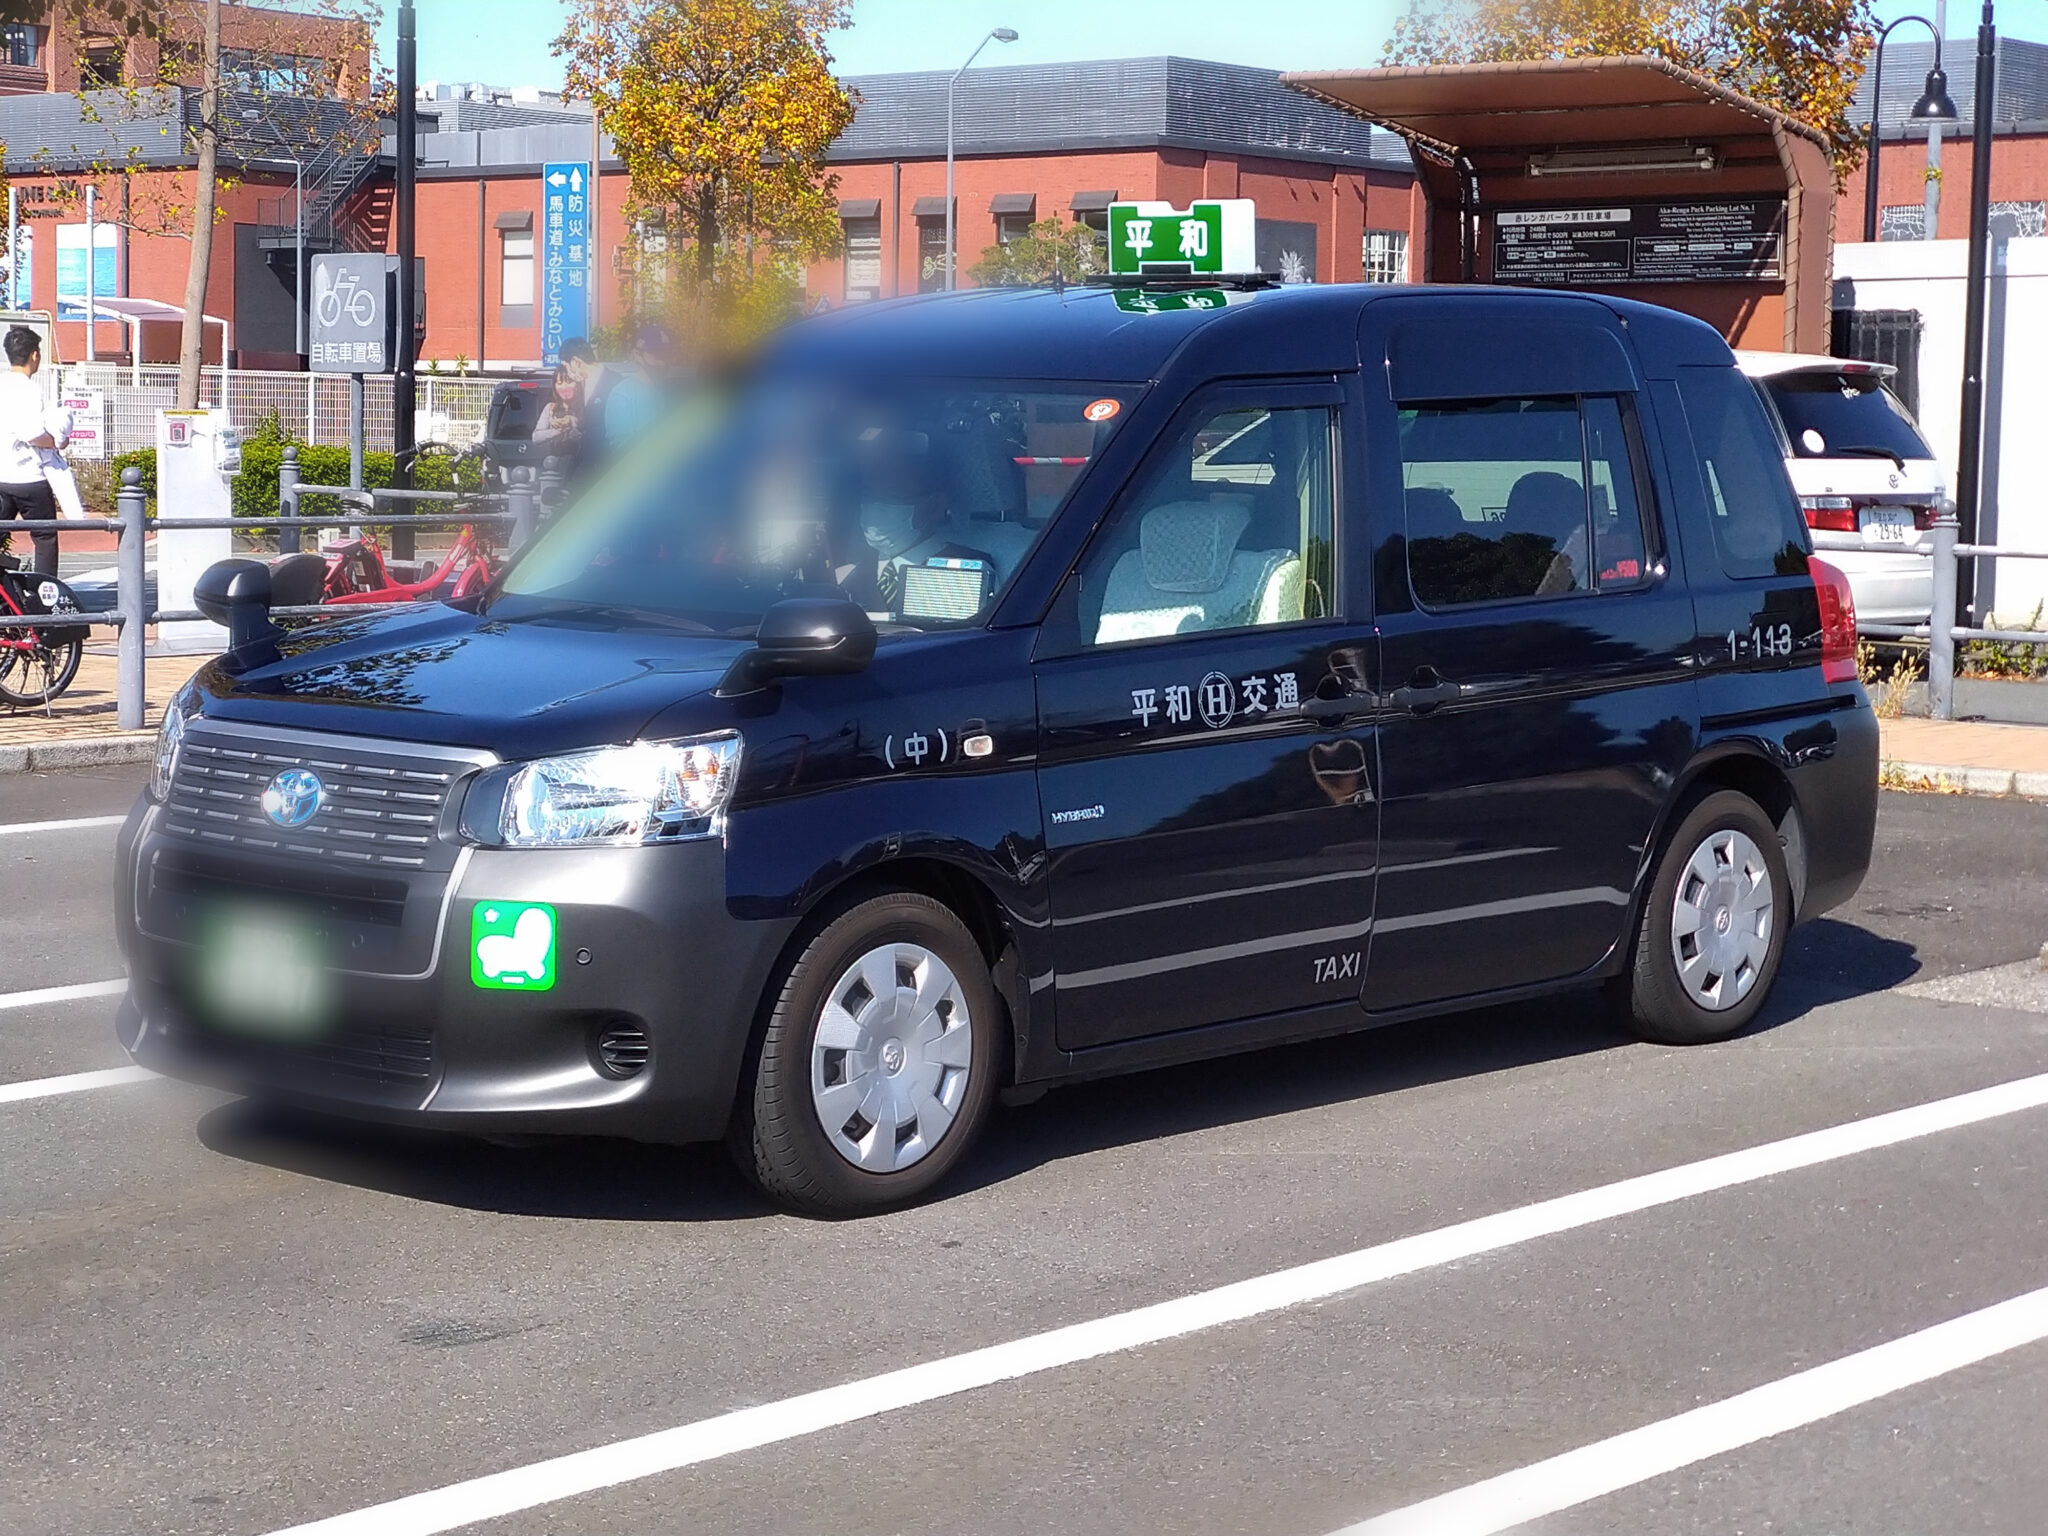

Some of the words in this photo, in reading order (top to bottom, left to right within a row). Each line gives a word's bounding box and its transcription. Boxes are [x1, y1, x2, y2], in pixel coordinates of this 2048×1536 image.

[1706, 205, 1728, 213] Parking
[568, 194, 584, 288] 防災基地
[1125, 219, 1208, 259] 平和
[312, 342, 381, 363] 自転車置場
[1727, 624, 1792, 661] 1-113
[1131, 685, 1192, 728] 平和
[1241, 672, 1300, 715] 交通
[1051, 807, 1097, 825] HYBRID
[1314, 951, 1361, 984] TAXI
